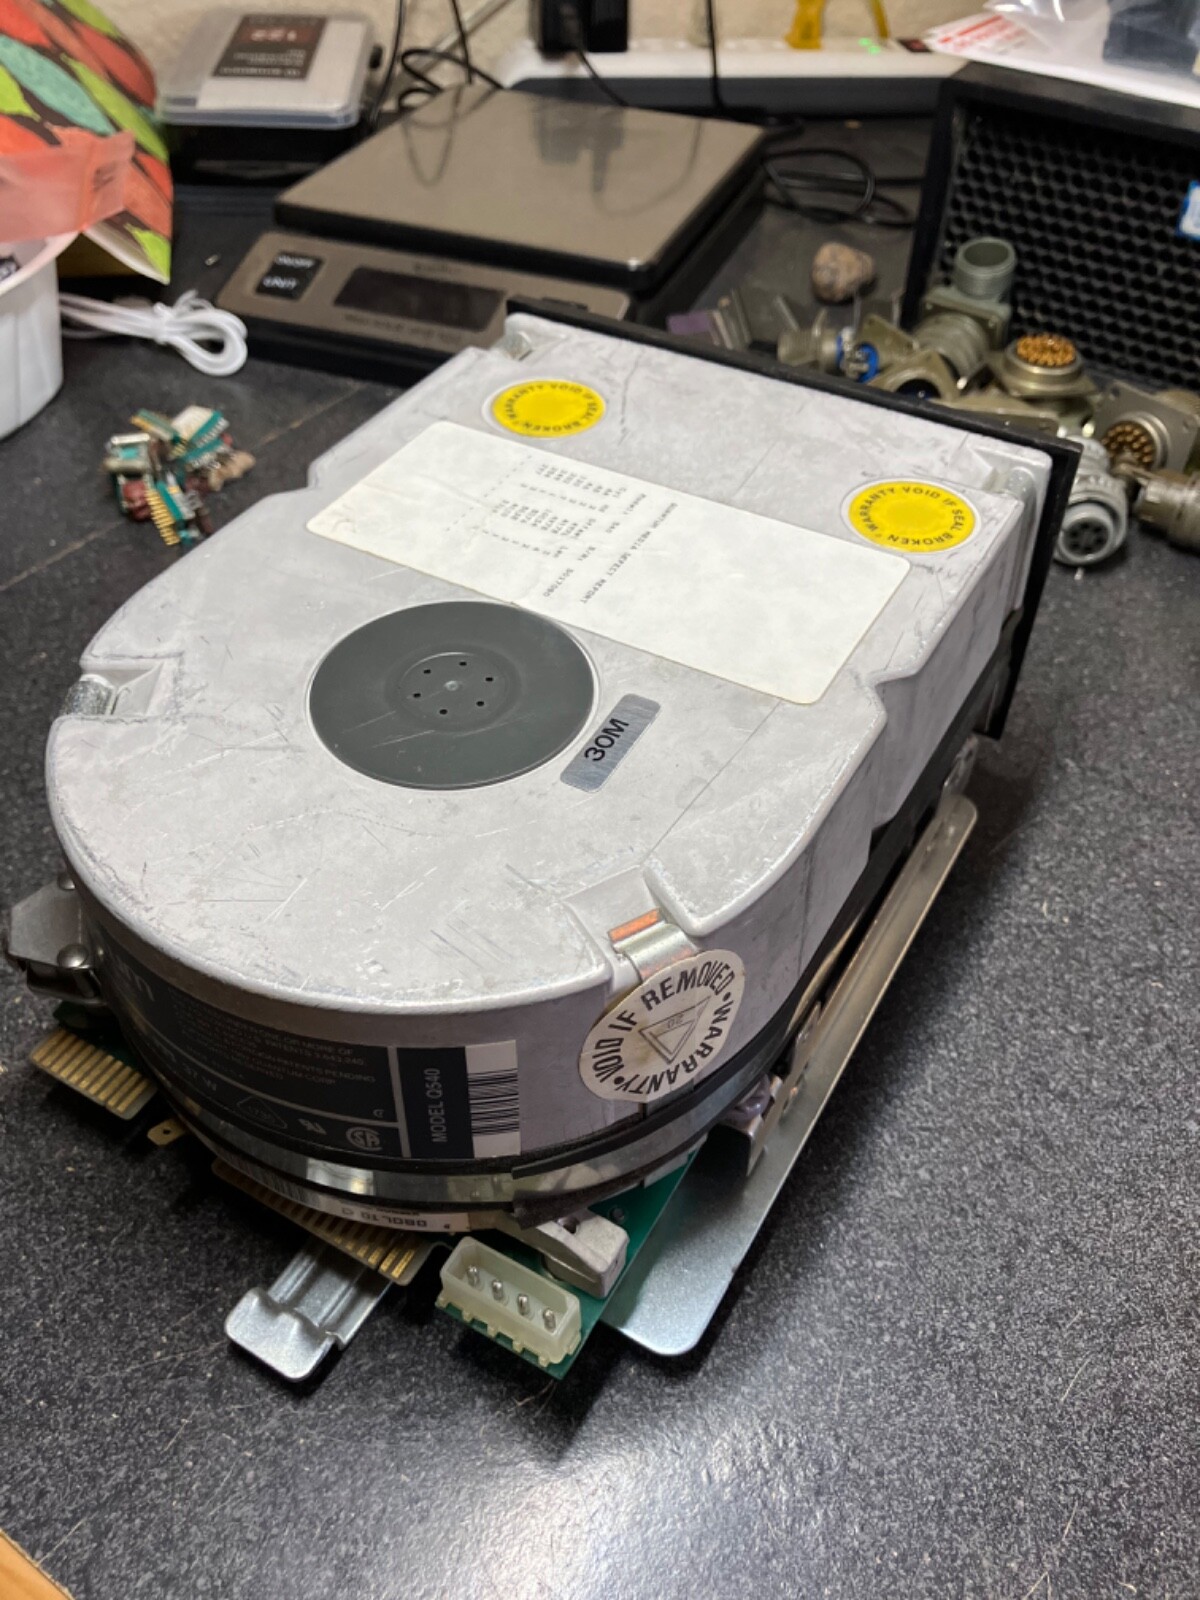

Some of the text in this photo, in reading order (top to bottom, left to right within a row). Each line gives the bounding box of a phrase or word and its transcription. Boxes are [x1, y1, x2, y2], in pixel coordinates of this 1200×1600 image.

[860, 487, 965, 545] WARRANTY VOID IF SEAL BROKEN
[580, 578, 606, 604] REPORT
[584, 718, 630, 762] 30M
[592, 960, 736, 1094] WARRANTY VOID IF REMOVED
[423, 1068, 448, 1142] MODEL Q540
